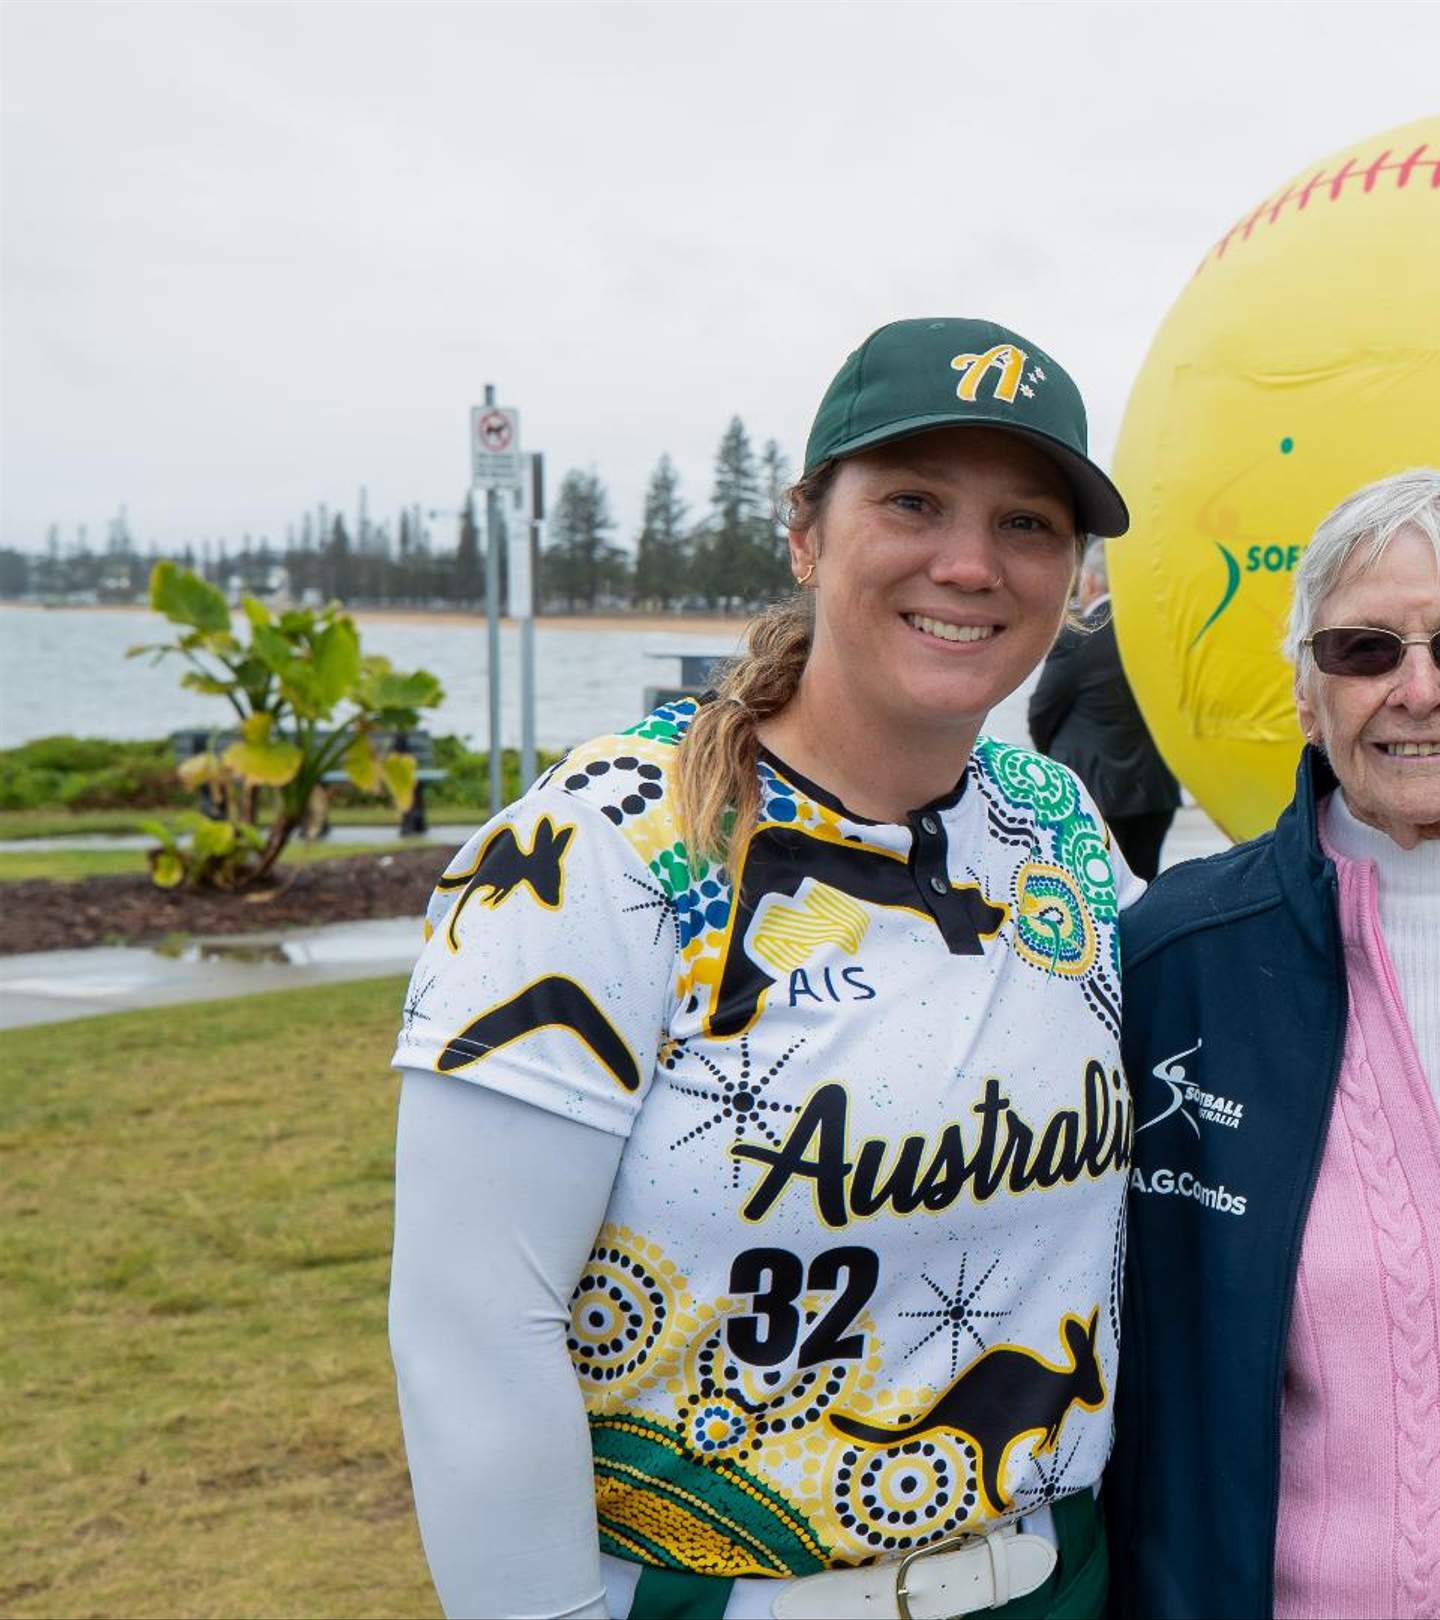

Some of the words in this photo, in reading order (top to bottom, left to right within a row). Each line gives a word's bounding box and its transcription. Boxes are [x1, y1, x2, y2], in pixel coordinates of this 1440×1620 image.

[950, 344, 1025, 403] A
[1246, 546, 1300, 572] SOF
[789, 966, 876, 1007] AIS
[727, 1246, 879, 1368] 32
